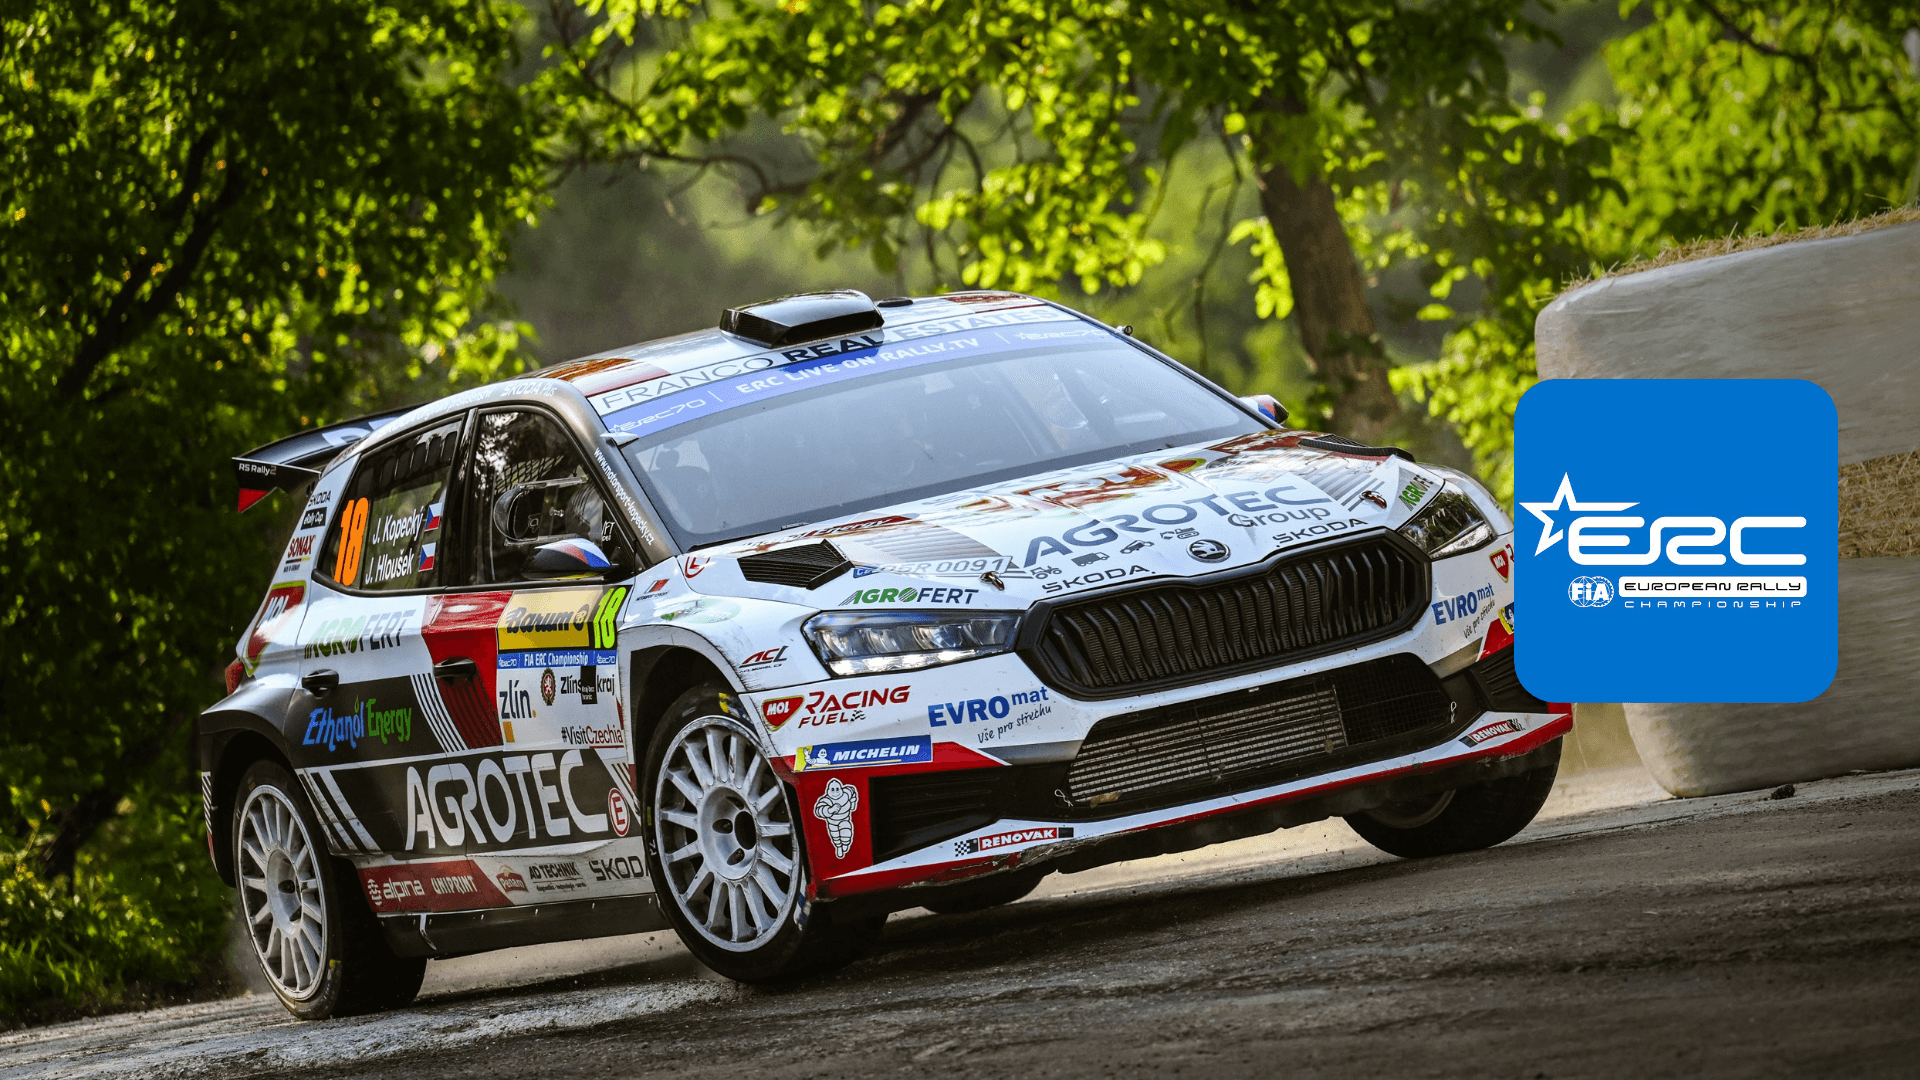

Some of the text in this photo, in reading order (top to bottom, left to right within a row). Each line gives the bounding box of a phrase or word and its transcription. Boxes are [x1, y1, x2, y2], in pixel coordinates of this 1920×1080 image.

[601, 309, 1060, 409] FRANCO REAL ESTATES
[735, 376, 785, 394] ERC
[784, 363, 840, 382] LIVE
[842, 356, 877, 369] ON
[879, 337, 980, 362] RALLY.TV
[238, 463, 277, 477] RS Rally2
[593, 446, 655, 546] www.motorsport-kopecky.cz
[372, 505, 424, 547] J. Kopecký
[1023, 485, 1333, 568] AGROTEC
[1227, 507, 1331, 528] Group
[334, 497, 369, 587] 18
[365, 547, 415, 585] J. Hloušek
[838, 587, 980, 607] AGROFERT
[505, 606, 574, 634] Barum
[593, 586, 627, 649] 18
[303, 608, 417, 660] AGROFERT
[523, 653, 534, 667] FIA
[535, 652, 547, 666] ERC
[547, 651, 589, 667] Championship
[596, 673, 615, 696] kraj
[766, 685, 911, 716] MOL RACING
[302, 698, 413, 752] Ethanol Energy
[561, 723, 624, 746] #VisitCzechia
[798, 712, 849, 729] FUEL
[997, 721, 1014, 739] pro
[1473, 722, 1511, 742] RENOVAK
[832, 744, 921, 763] MICHELIN
[405, 749, 609, 851] AGROTEC
[981, 829, 1055, 850] RENOVAK
[383, 877, 426, 902] alpina
[430, 875, 478, 895] UNIPRINT
[528, 865, 542, 880] AD
[542, 862, 581, 879] TECHNIK
